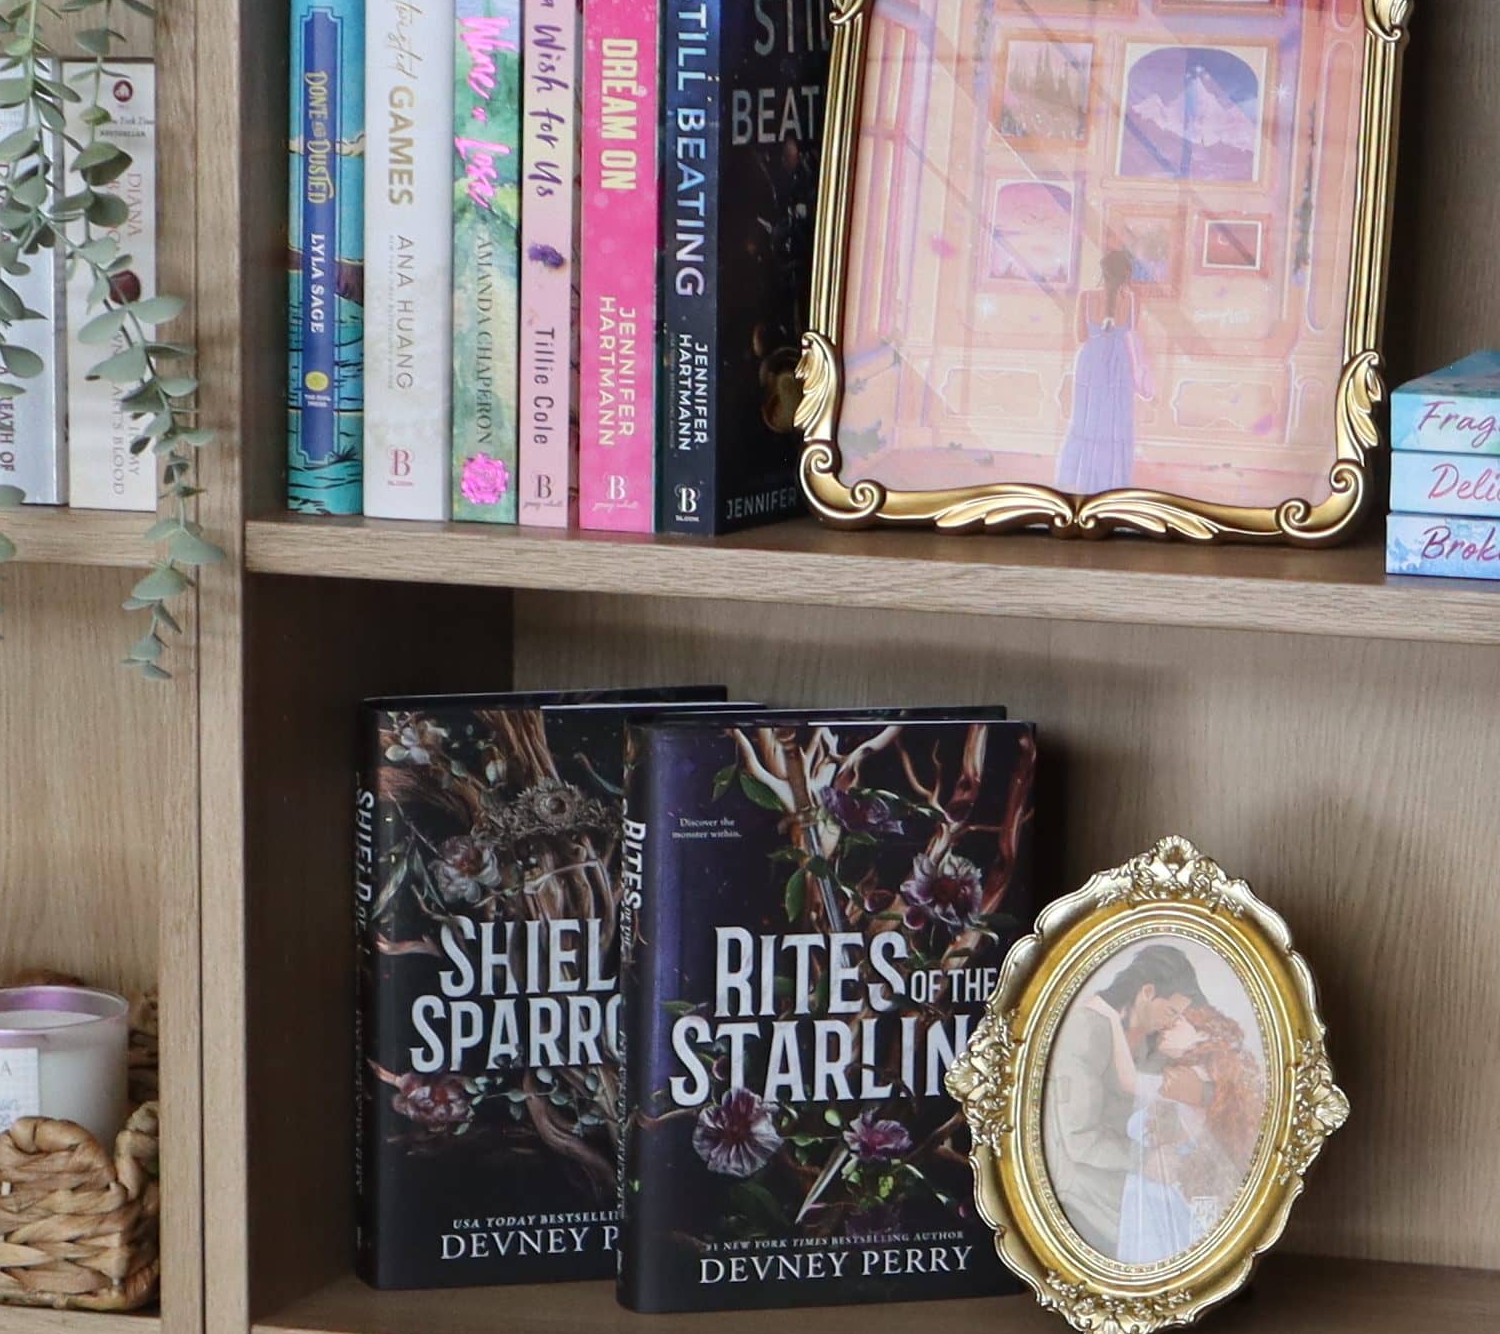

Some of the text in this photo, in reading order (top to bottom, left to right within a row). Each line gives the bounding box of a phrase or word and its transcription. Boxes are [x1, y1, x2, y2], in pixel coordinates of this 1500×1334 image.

[599, 37, 639, 192] DREAM ON
[674, 106, 708, 298] BEATING
[308, 232, 325, 335] LYLA SAGE
[715, 925, 908, 1019] RITES
[700, 1245, 973, 1284] DEVNEY PERRY
[724, 1231, 964, 1251] NEW YORK TIMES BESTSELLING AUTHOR
